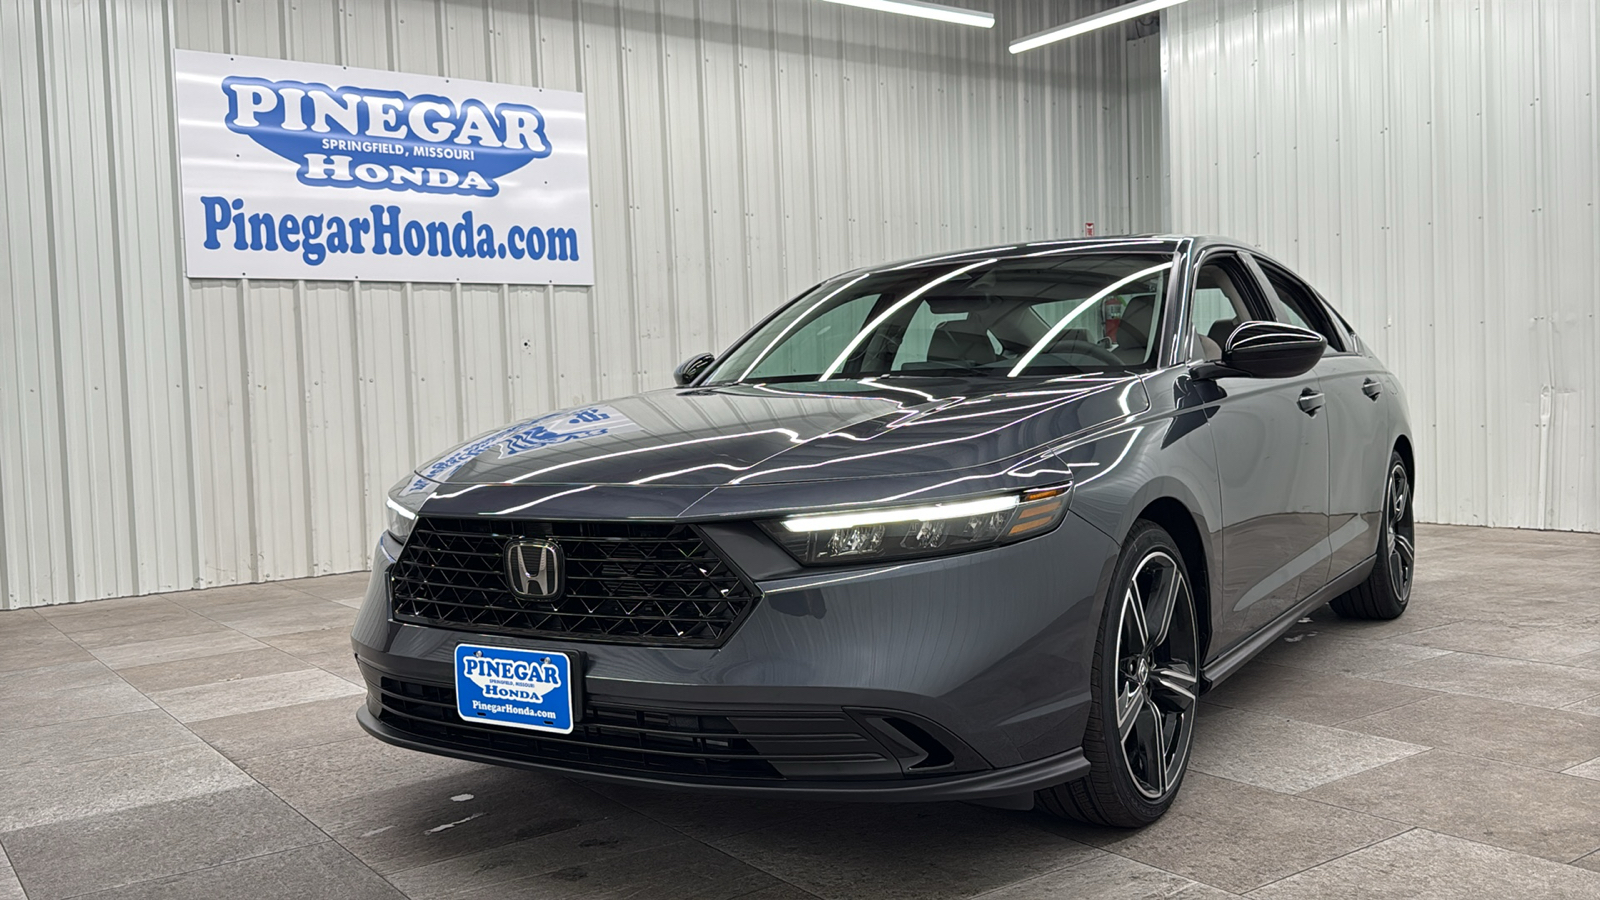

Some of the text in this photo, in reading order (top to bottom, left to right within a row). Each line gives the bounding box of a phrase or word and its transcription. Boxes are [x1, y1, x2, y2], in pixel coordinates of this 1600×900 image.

[229, 83, 546, 152] PINEGAR
[321, 138, 475, 161] SPRINGFIELD, MISSOURI
[303, 153, 493, 191] HONDA
[200, 196, 580, 266] PinegarHonda.com
[465, 659, 559, 685] PINEGAR
[484, 685, 541, 701] HONDA
[472, 700, 557, 720] PinegarHonda.com
